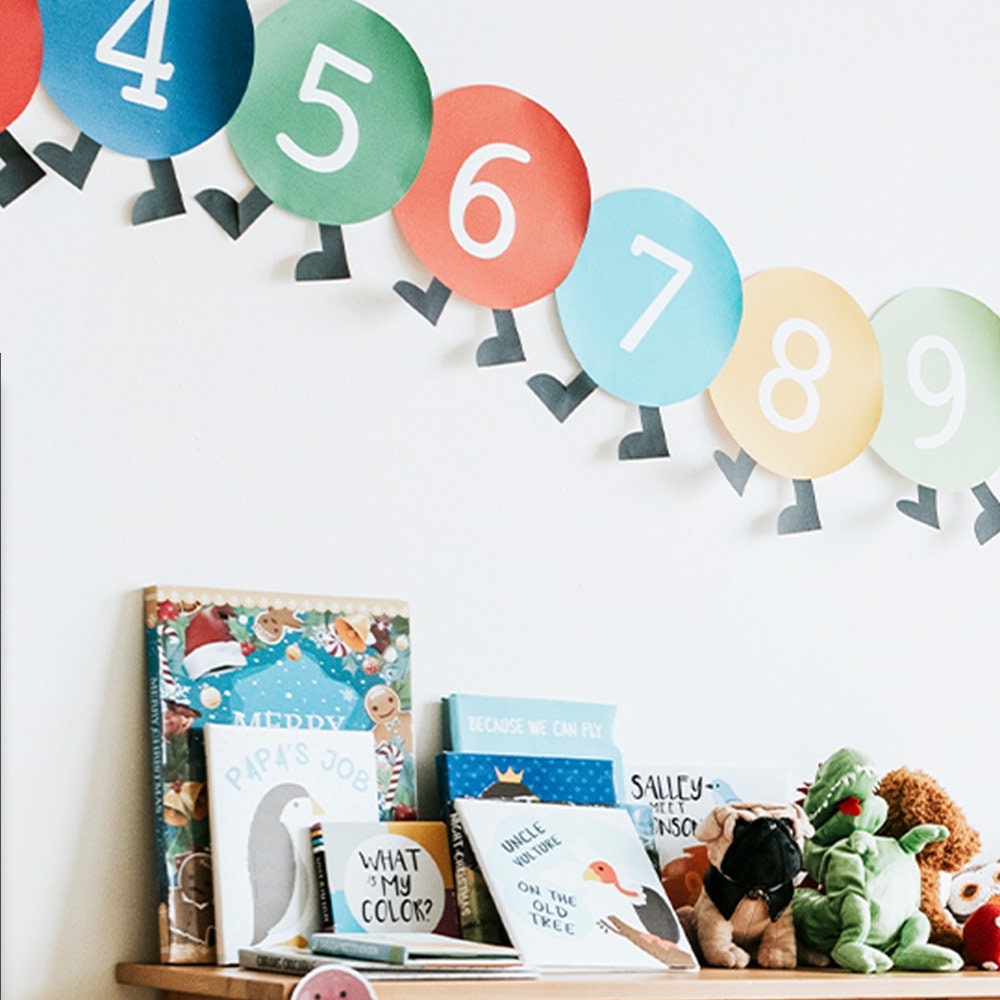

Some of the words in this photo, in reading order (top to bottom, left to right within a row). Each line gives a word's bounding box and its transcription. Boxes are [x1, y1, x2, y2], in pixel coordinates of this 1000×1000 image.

[95, 0, 175, 111] 4
[276, 43, 373, 172] 5
[449, 142, 530, 258] 6
[620, 234, 693, 353] 7
[758, 318, 831, 433] 8
[907, 334, 967, 450] 9
[467, 715, 524, 735] BECAUSE
[527, 718, 547, 736] WE
[552, 720, 577, 738] CAN
[581, 721, 603, 740] FLY
[225, 742, 309, 791] PAPA'S
[321, 749, 370, 792] JOB
[631, 774, 703, 801] SALLEY
[501, 820, 546, 853] UNCLE
[512, 834, 562, 868] VULTURE
[358, 848, 422, 871] WHAT
[362, 898, 433, 923] COLOR?
[518, 881, 541, 896] ON
[548, 889, 577, 907] THE
[532, 899, 568, 918] OLD
[529, 911, 575, 935] TREE
